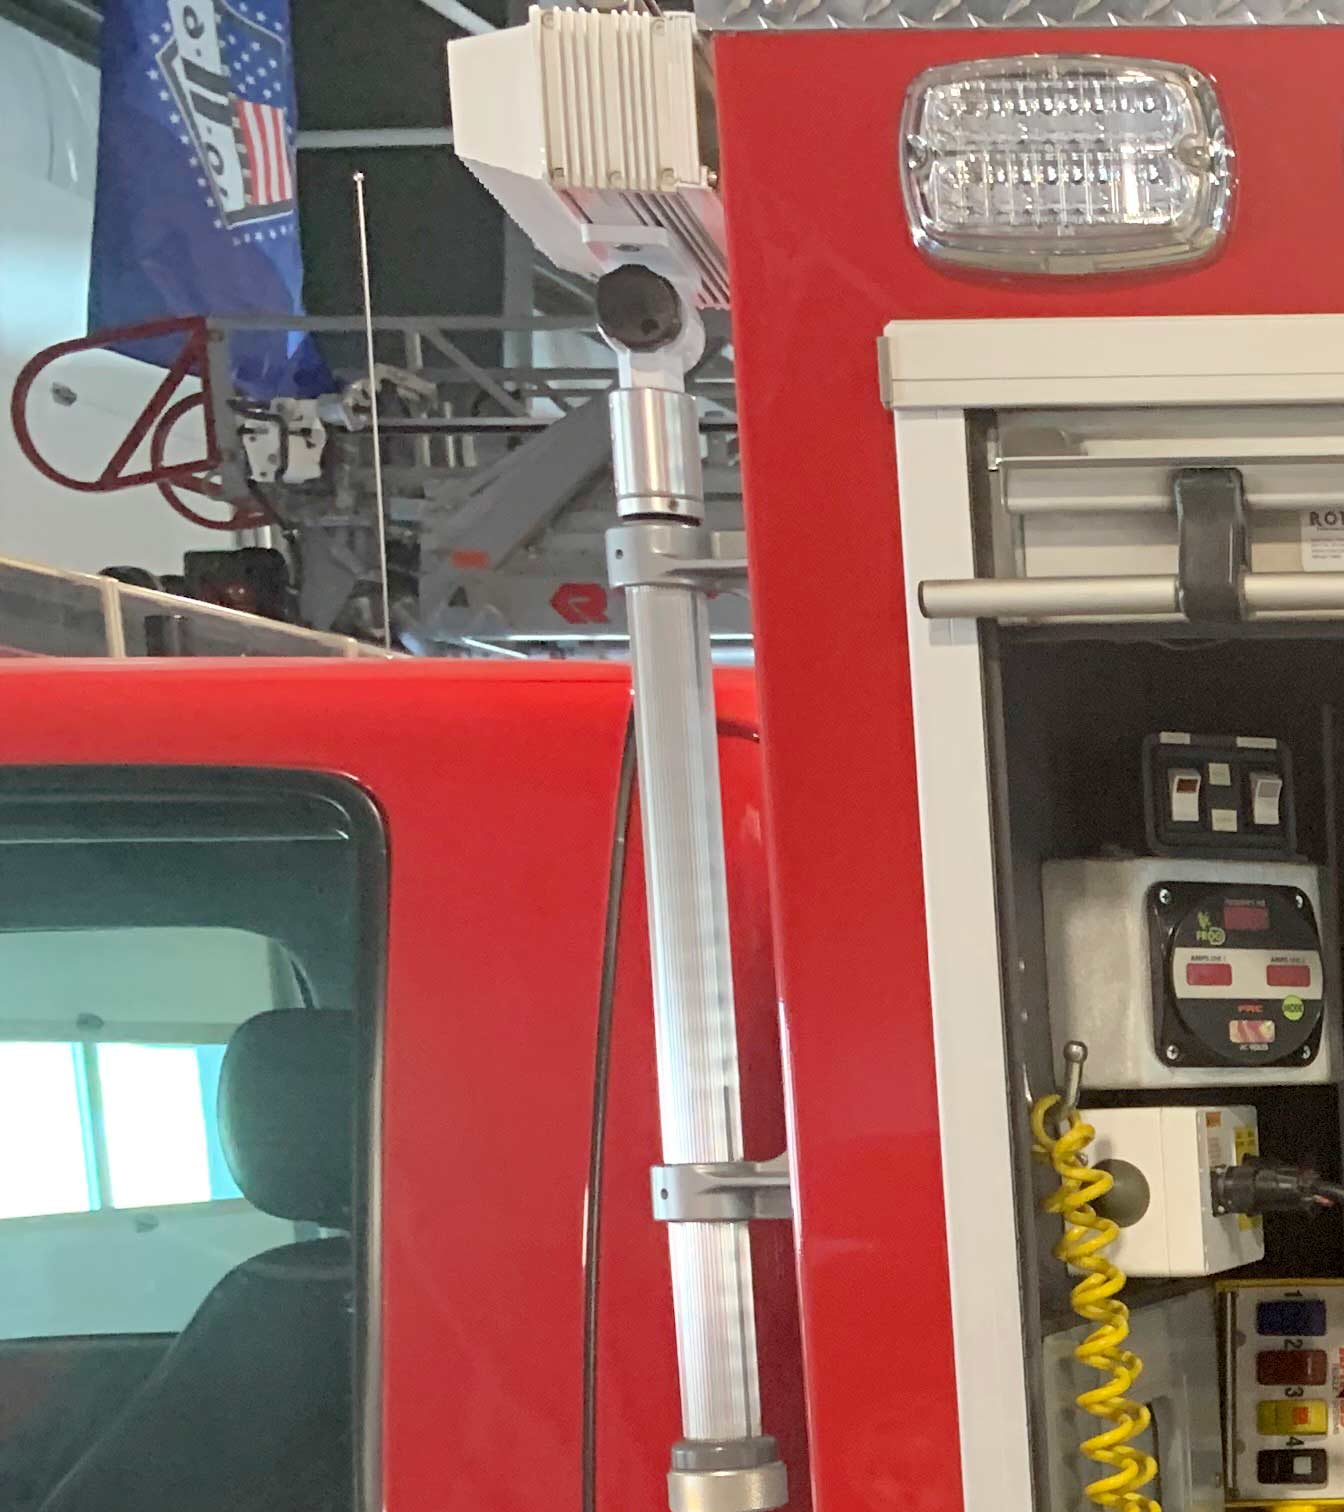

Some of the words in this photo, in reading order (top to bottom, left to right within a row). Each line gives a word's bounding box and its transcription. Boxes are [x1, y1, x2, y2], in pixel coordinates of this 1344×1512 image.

[1284, 1339, 1303, 1349] 2
[1285, 1386, 1304, 1397] 3
[1286, 1436, 1304, 1447] 4
